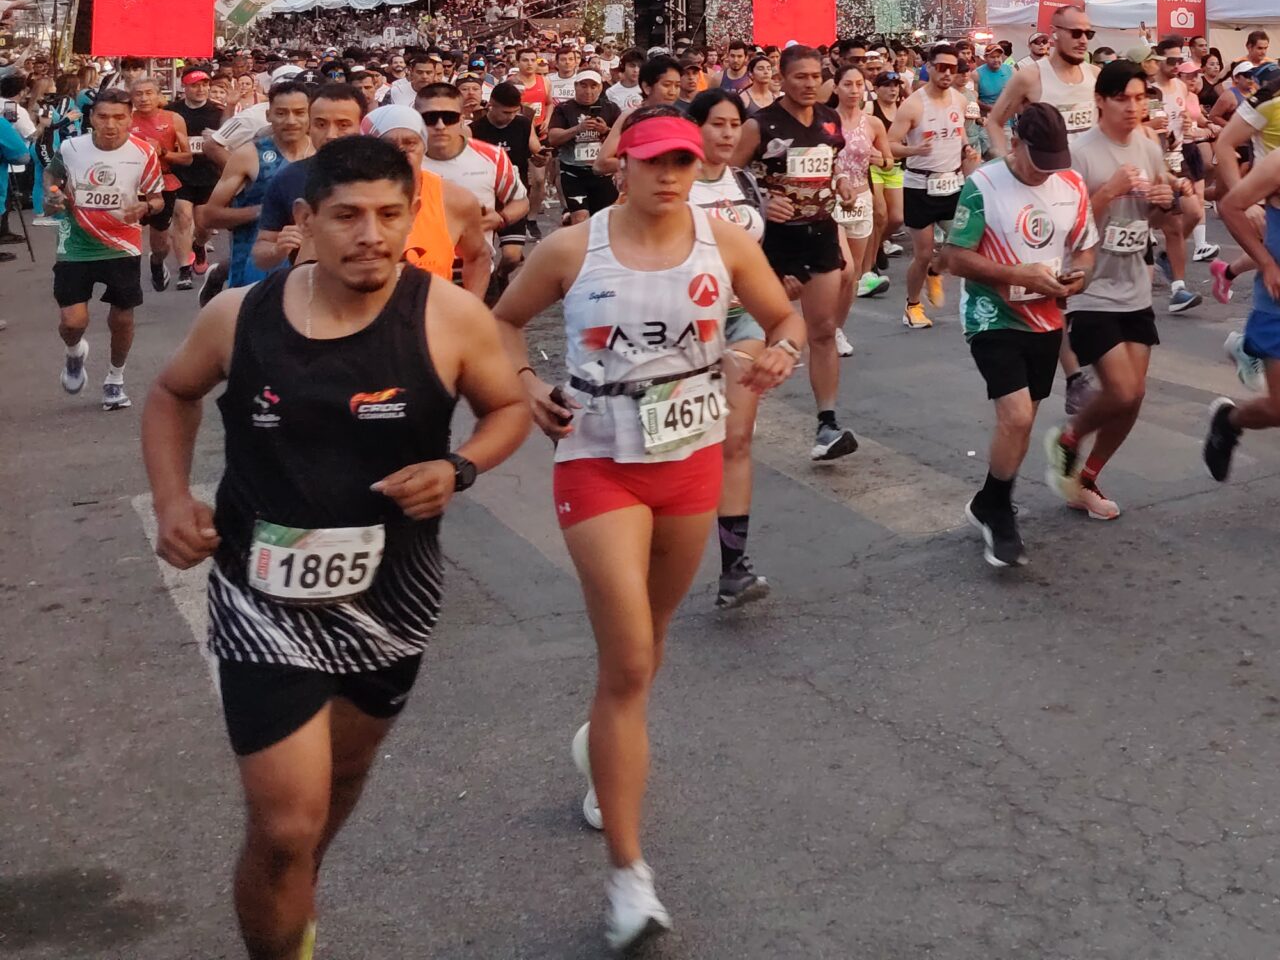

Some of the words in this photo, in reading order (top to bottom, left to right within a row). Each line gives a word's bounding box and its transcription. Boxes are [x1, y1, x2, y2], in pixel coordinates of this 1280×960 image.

[1067, 110, 1092, 127] 4652
[800, 157, 830, 174] 1325
[85, 192, 120, 206] 2082
[607, 320, 698, 350] ABA
[663, 392, 720, 431] 4670
[279, 551, 370, 589] 1865
